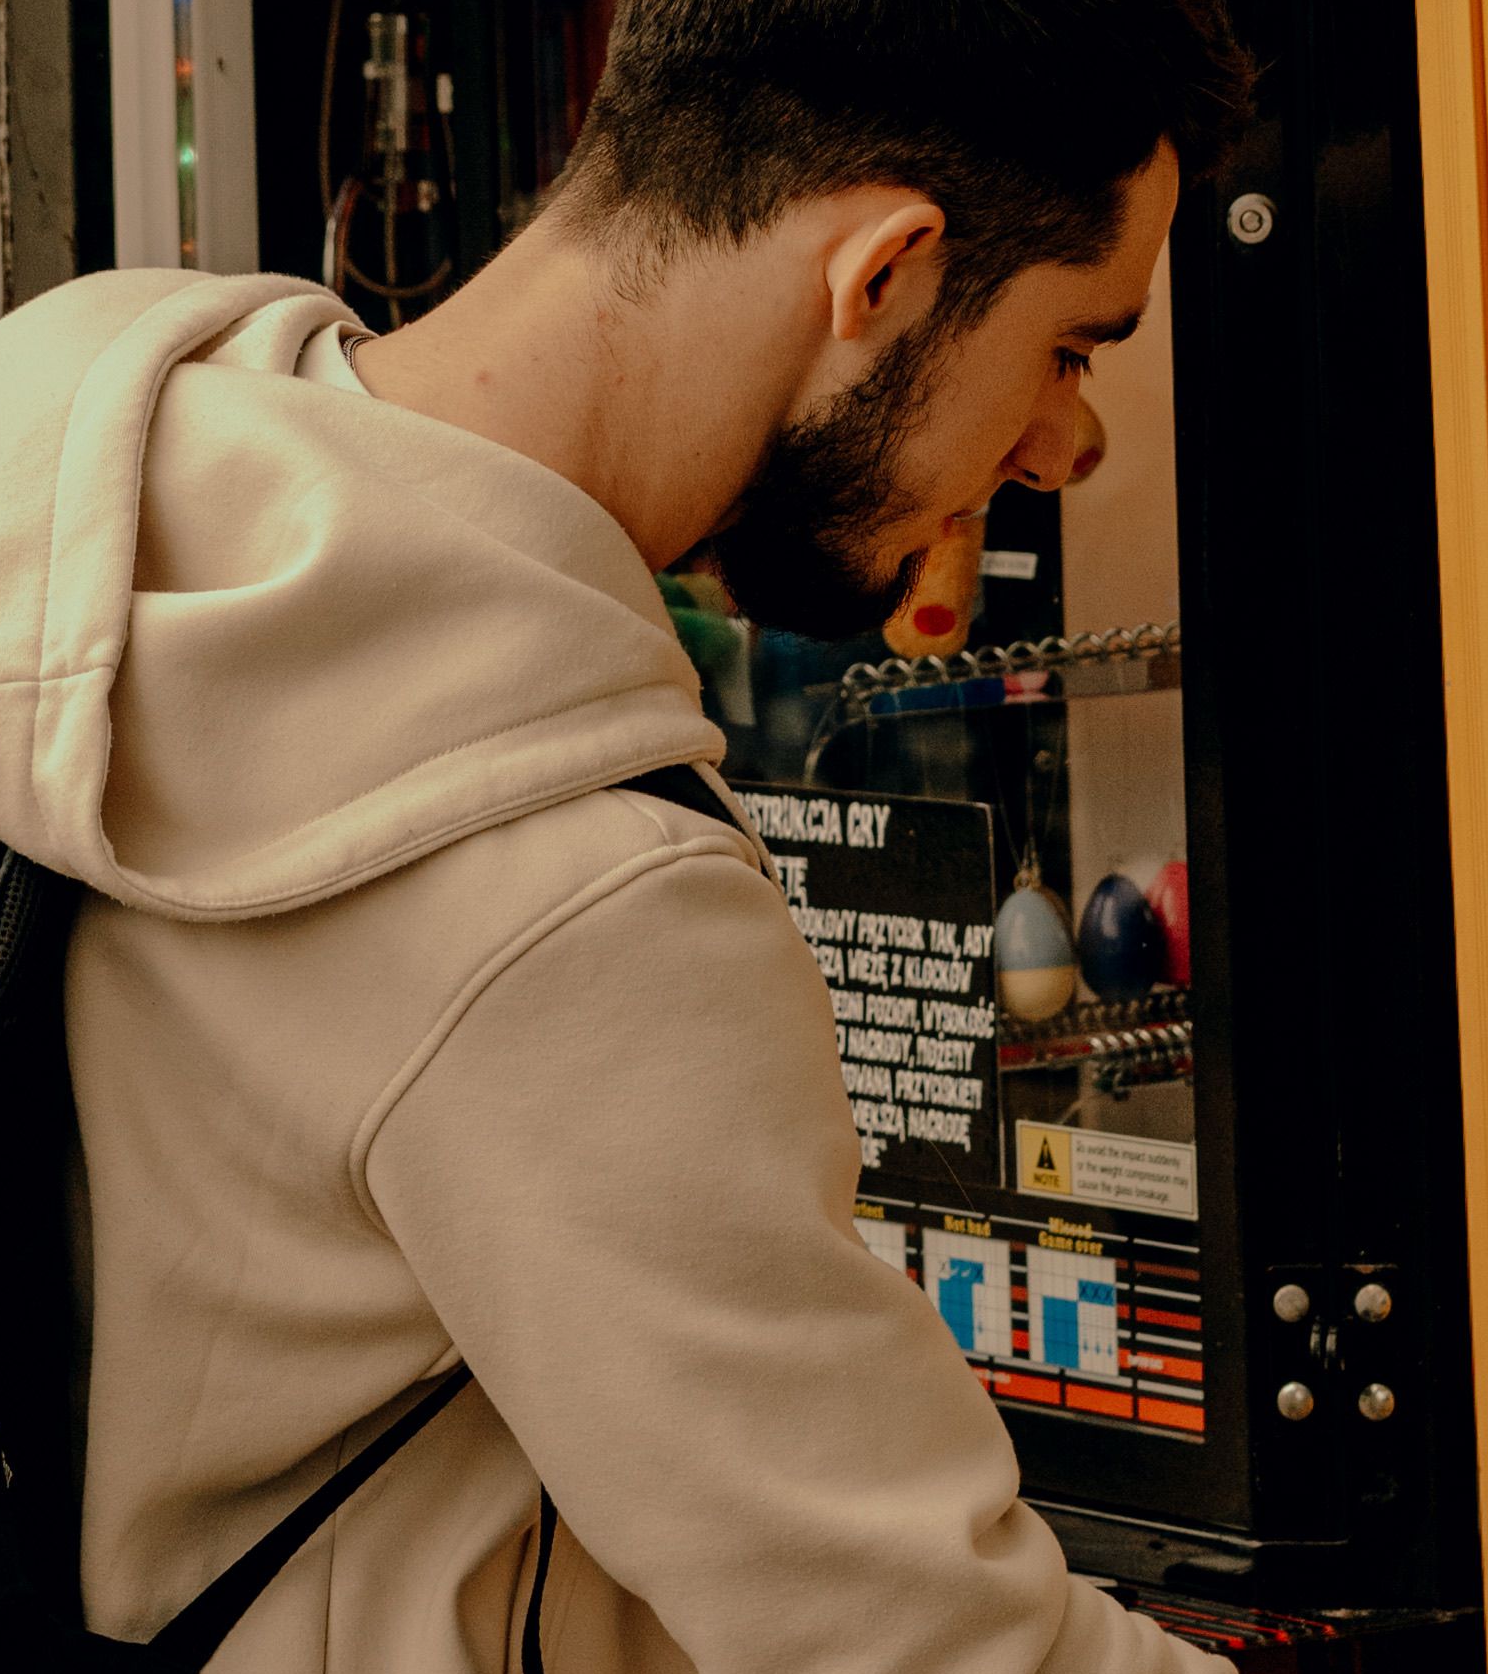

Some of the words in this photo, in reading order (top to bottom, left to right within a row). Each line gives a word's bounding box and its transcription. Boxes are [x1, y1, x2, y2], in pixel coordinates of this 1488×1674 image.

[846, 801, 891, 849] GRY
[928, 920, 961, 959] TAK,
[963, 925, 995, 959] ABY
[890, 954, 903, 986] Z
[1032, 1172, 1061, 1189] NOTE
[1038, 1230, 1074, 1251] Game
[1075, 1238, 1104, 1257] over
